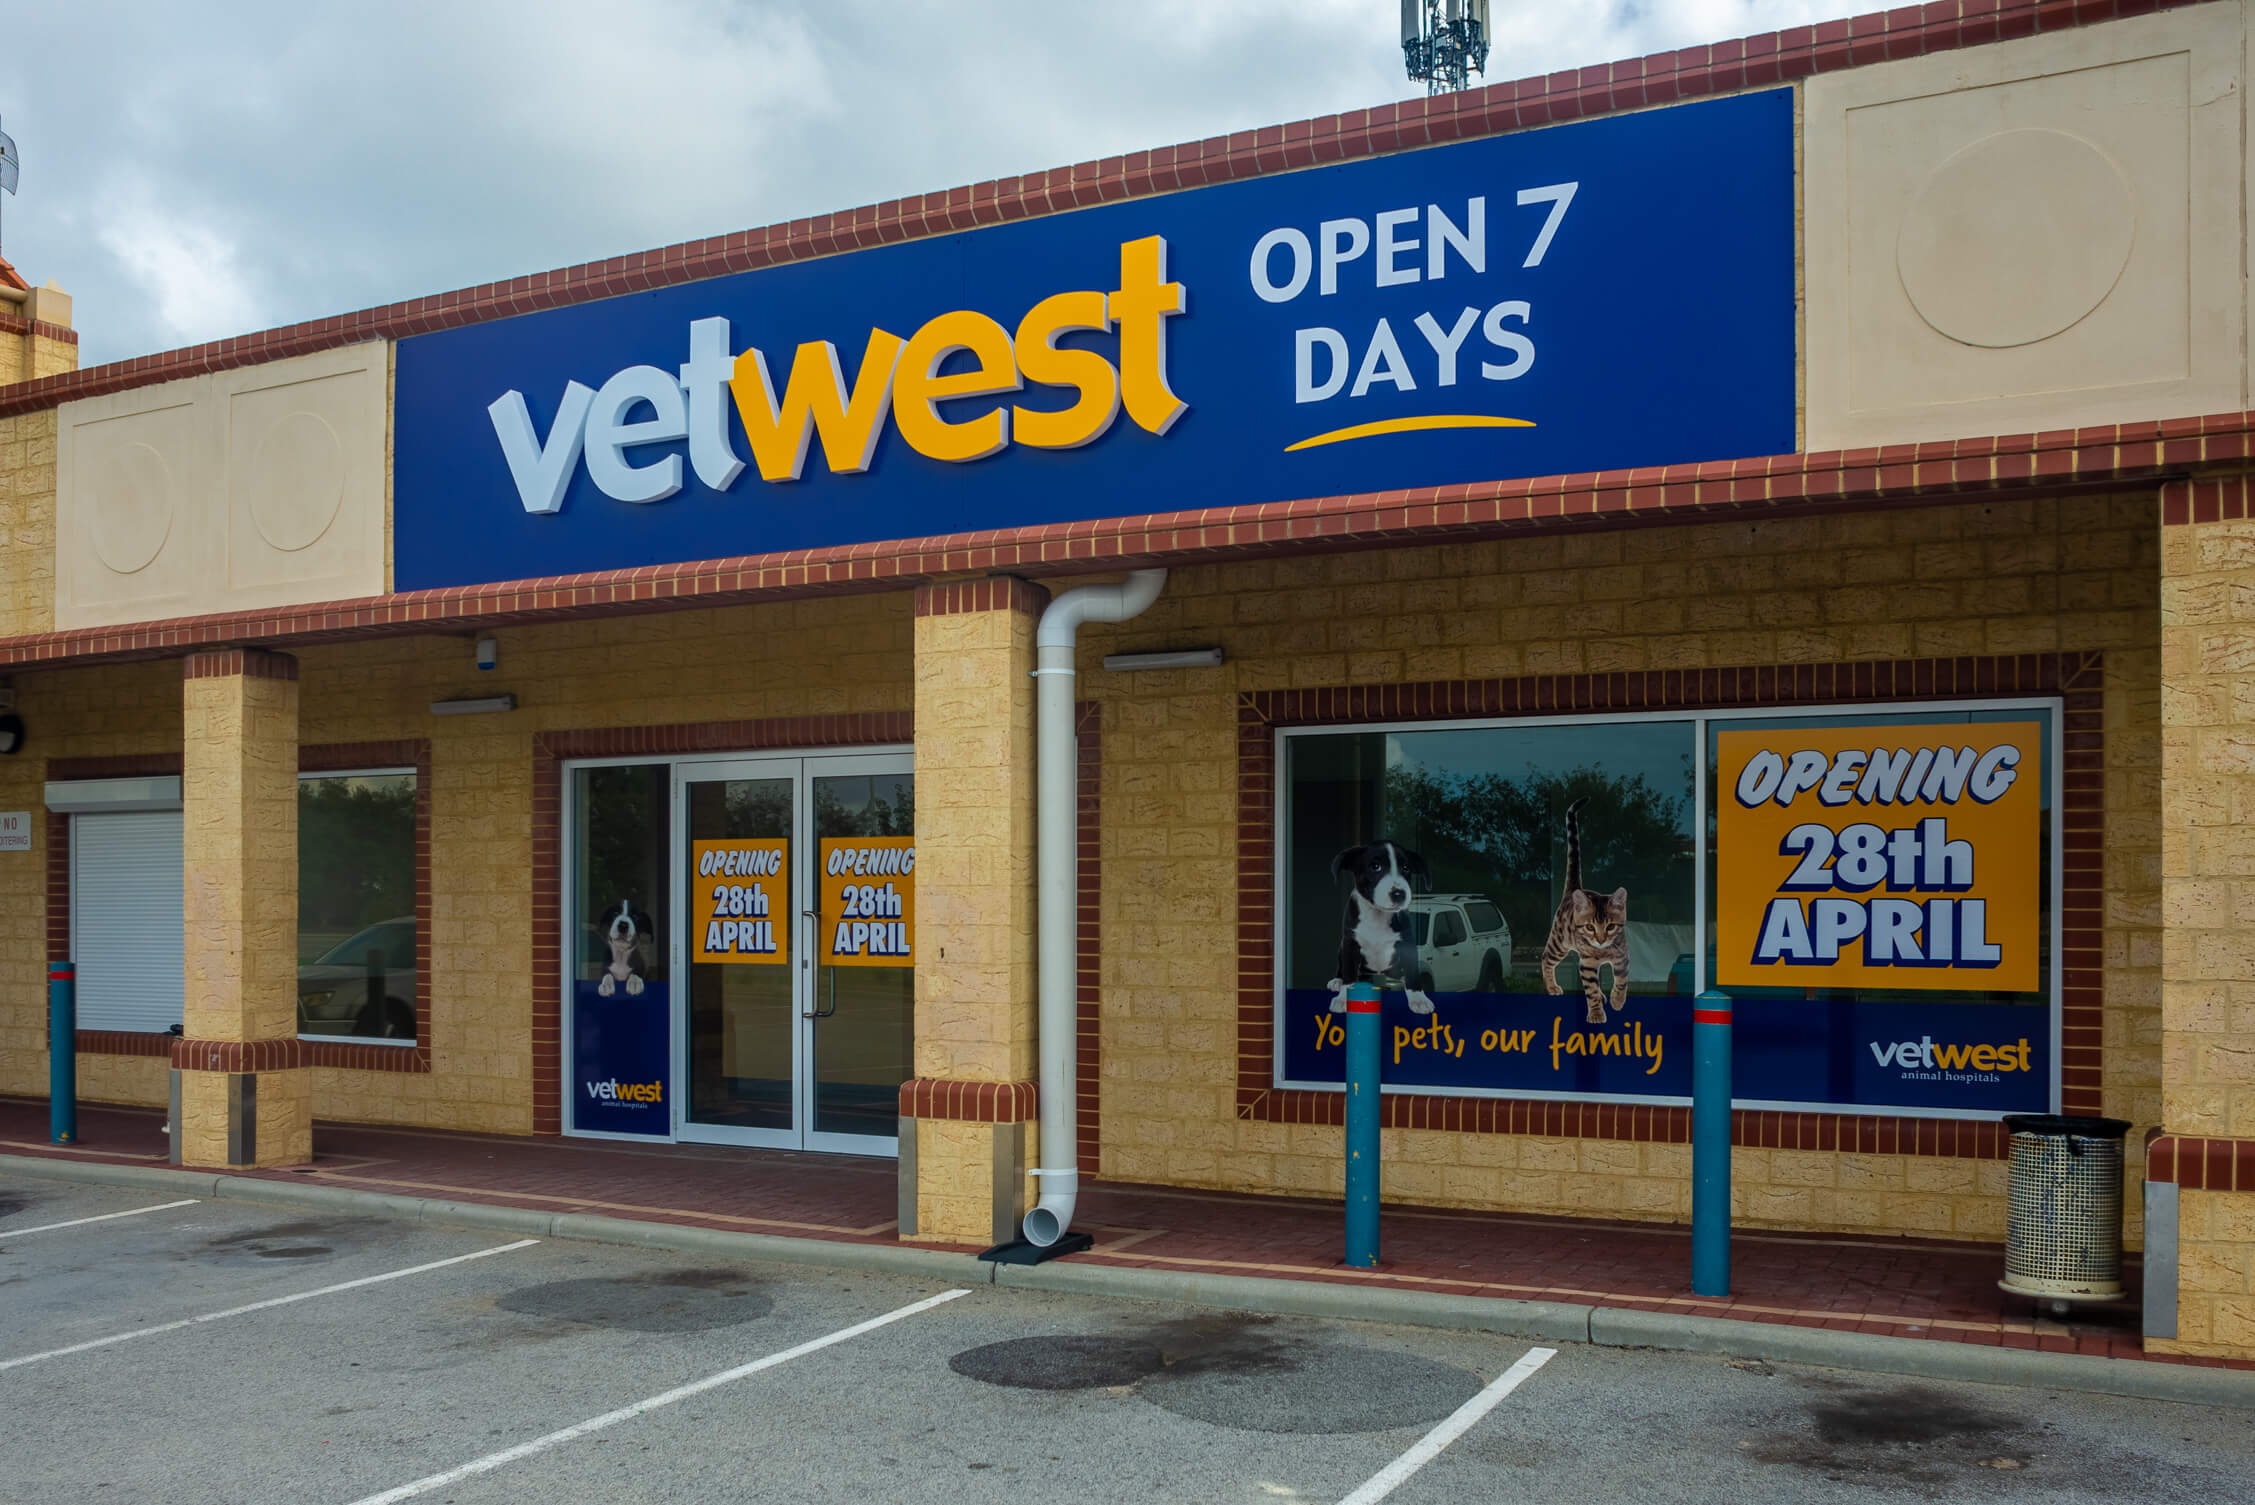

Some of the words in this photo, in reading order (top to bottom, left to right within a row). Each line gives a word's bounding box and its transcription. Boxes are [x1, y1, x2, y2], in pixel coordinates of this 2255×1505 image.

[1250, 196, 1486, 303] OPEN
[1516, 181, 1579, 268] 7
[1295, 300, 1536, 404] DAYS
[487, 234, 1190, 514] vetwest
[1735, 744, 2021, 809] OPENING
[699, 849, 782, 877] OPENING
[826, 847, 915, 877] OPENING
[1776, 817, 1974, 893] 28th
[712, 882, 769, 918] 28th
[841, 882, 902, 919] 28th
[704, 920, 777, 954] APRIL
[832, 921, 911, 956] APRIL
[1750, 898, 2002, 969] APRIL
[1315, 1013, 1346, 1050] Yo
[1393, 1013, 1465, 1064] pets,
[1480, 1028, 1536, 1053] our
[1548, 1016, 1663, 1075] family
[1869, 1035, 2031, 1072] vetwest
[586, 1078, 662, 1102] vetwest
[1901, 1071, 1941, 1081] animal
[1945, 1071, 2000, 1084] hospitals
